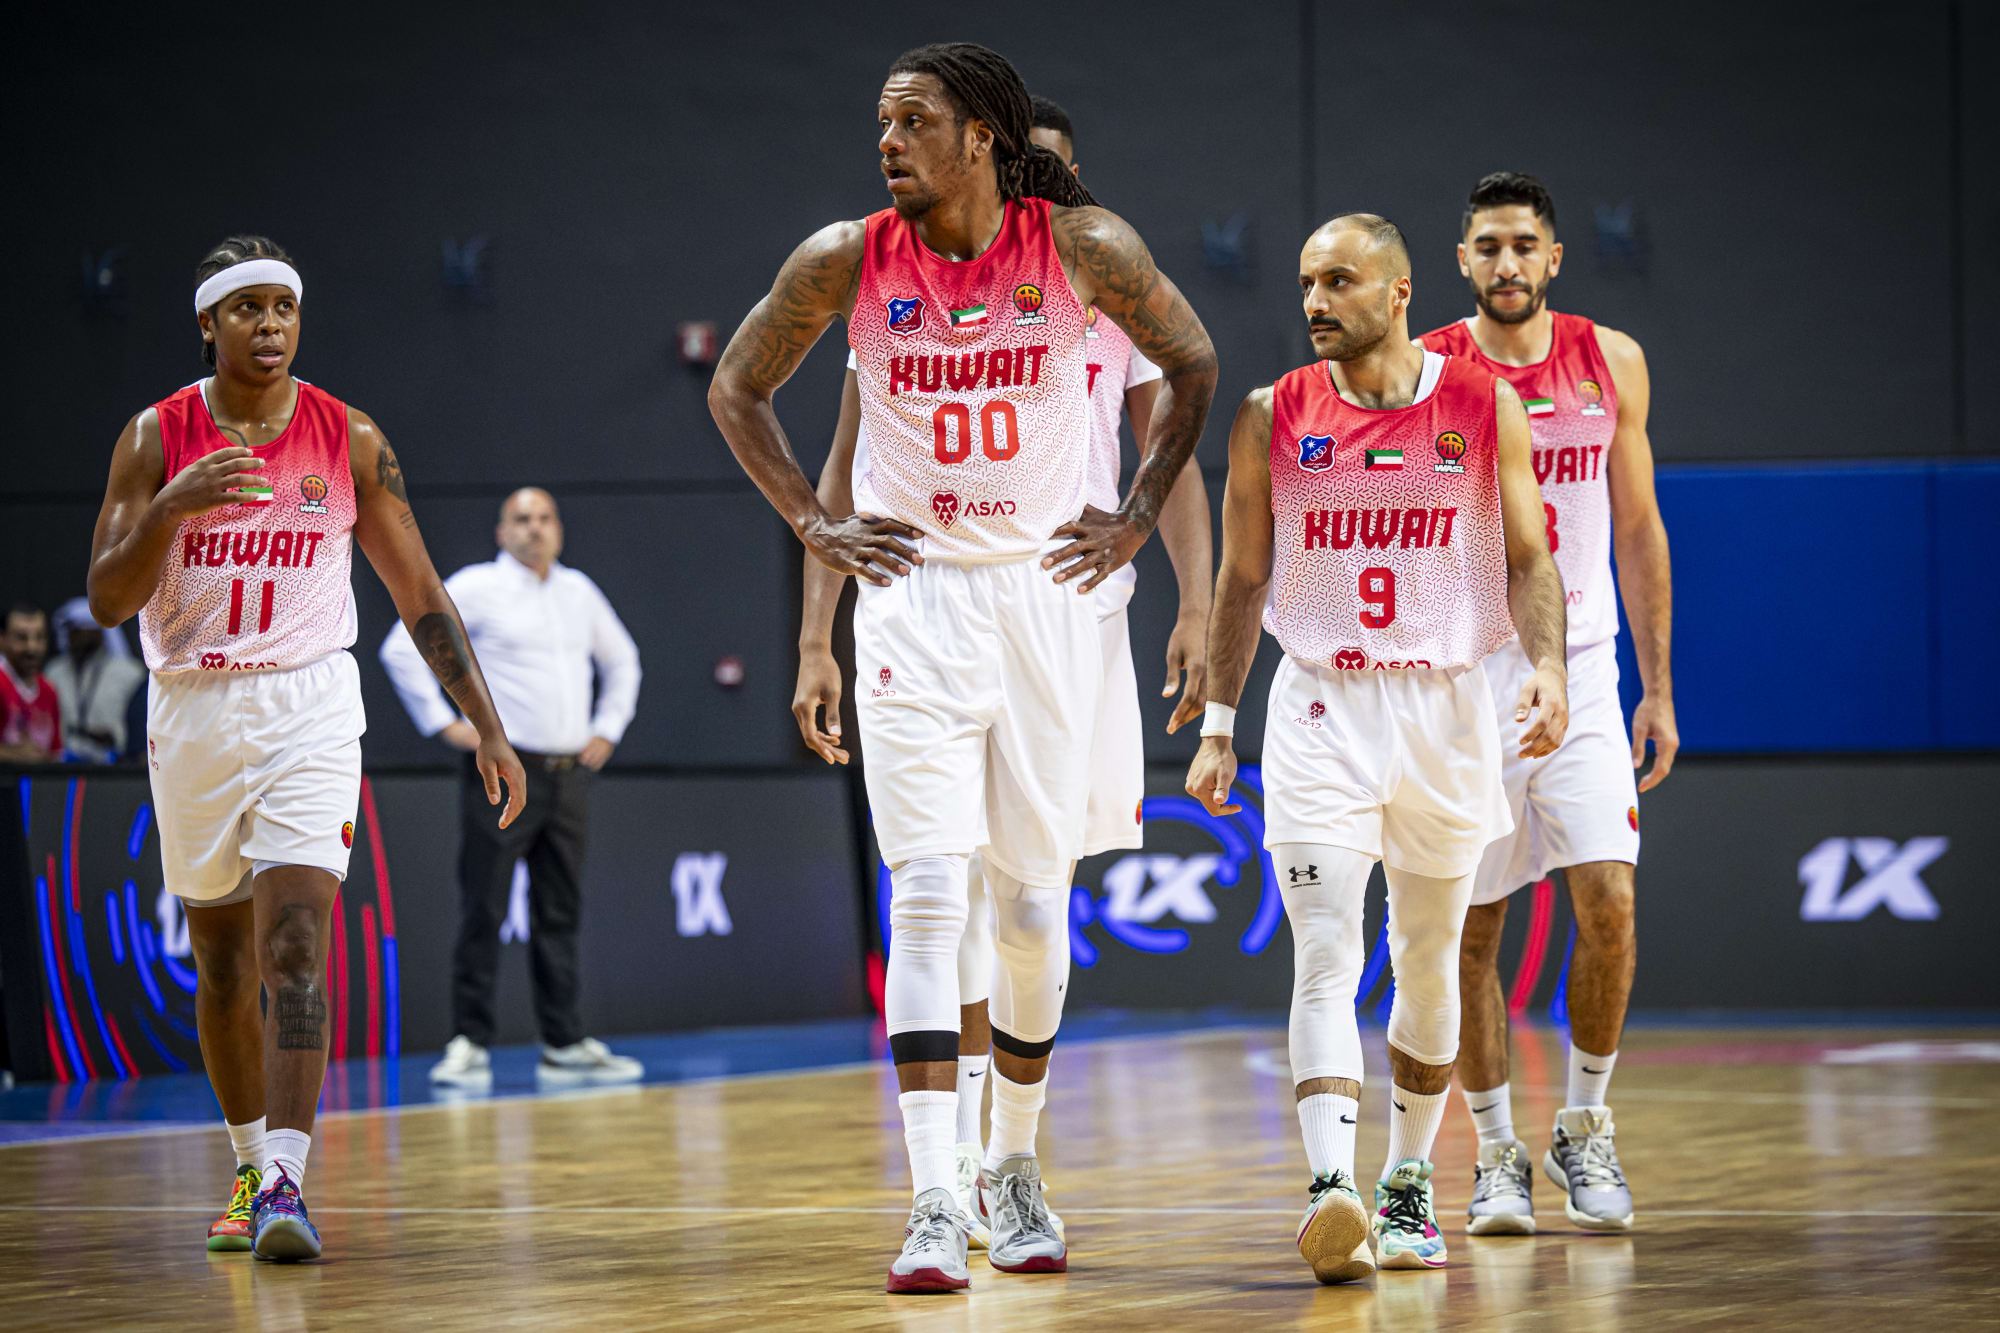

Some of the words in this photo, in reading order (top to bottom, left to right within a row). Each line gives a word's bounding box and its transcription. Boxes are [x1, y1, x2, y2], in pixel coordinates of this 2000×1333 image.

[889, 345, 1048, 396] KUWAIT
[933, 400, 1020, 464] 00
[964, 501, 1016, 517] ASAD
[1305, 508, 1457, 550] KUWAIT
[184, 531, 323, 568] KUWAIT
[228, 579, 274, 635] 11
[1358, 567, 1395, 629] 9
[671, 852, 734, 937] 1X
[1102, 853, 1220, 923] 1X
[1798, 836, 1950, 921] 1X
